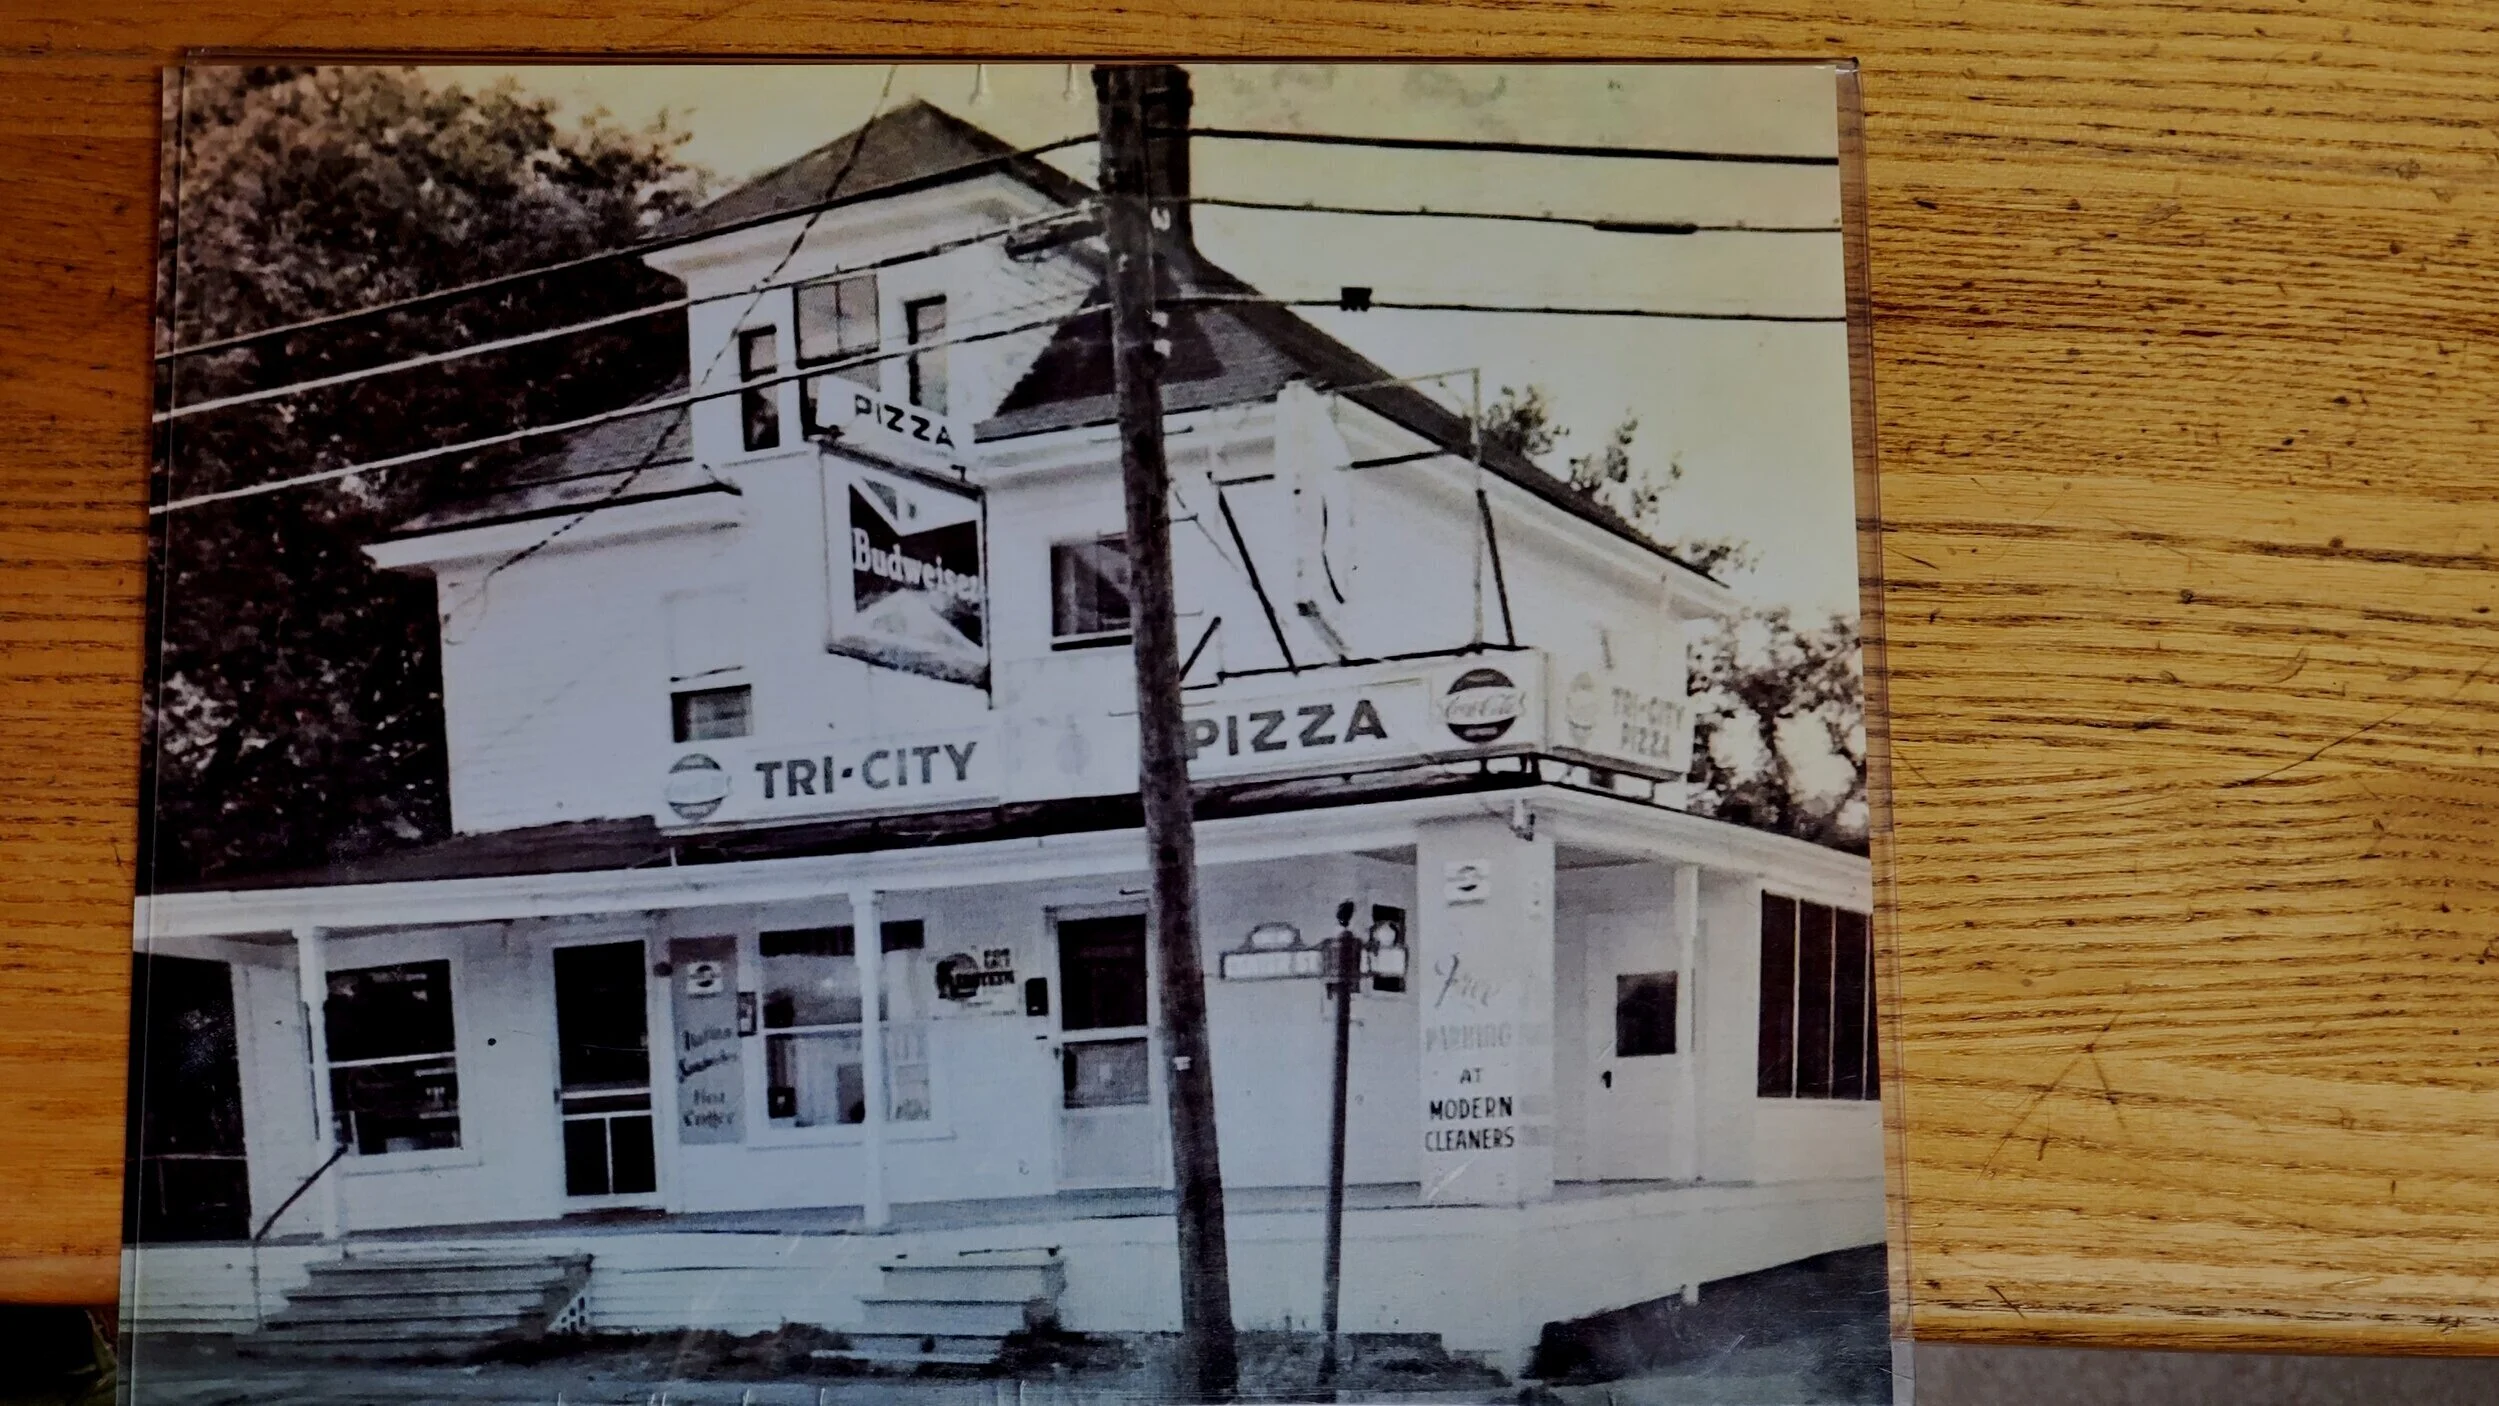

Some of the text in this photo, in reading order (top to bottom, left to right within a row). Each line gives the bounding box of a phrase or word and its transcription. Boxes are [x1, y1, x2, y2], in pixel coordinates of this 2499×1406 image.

[855, 394, 955, 450] PIZZA
[852, 527, 979, 604] Budweiser
[1181, 699, 1388, 760] PIZZA
[1459, 1067, 1482, 1084] AT
[1429, 1096, 1513, 1120] MODERN
[1425, 1126, 1515, 1152] CLEANERS
